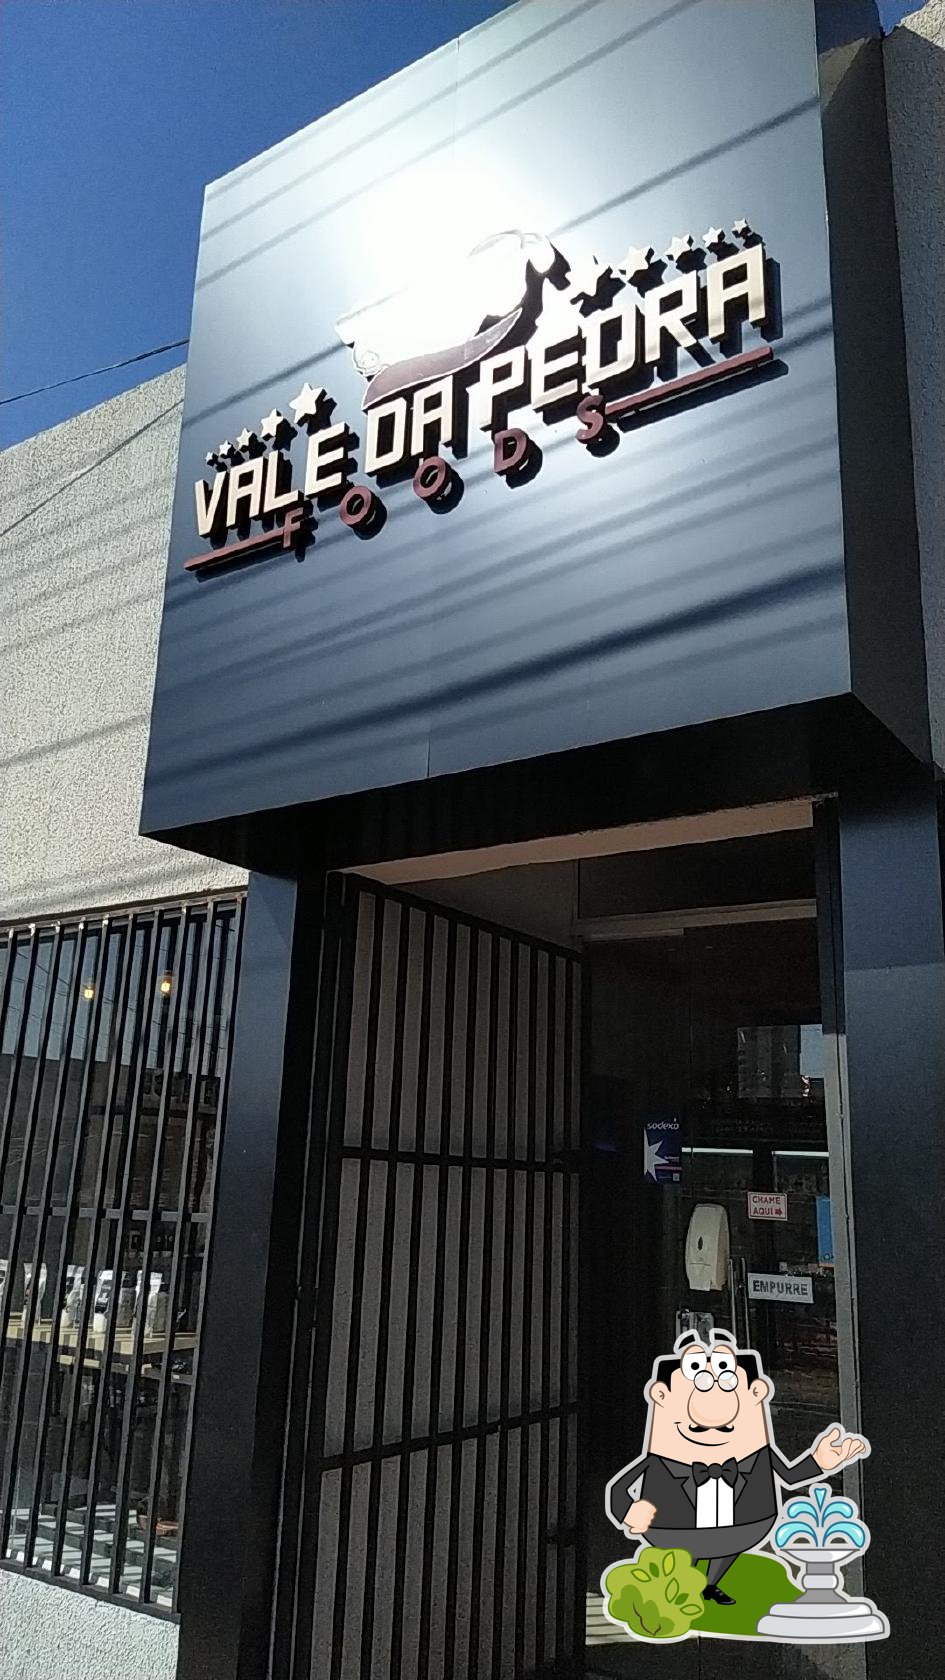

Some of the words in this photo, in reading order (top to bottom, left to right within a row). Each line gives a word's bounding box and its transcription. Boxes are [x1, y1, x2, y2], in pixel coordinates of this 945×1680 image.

[194, 421, 348, 537] VALE
[364, 376, 453, 476] DA
[467, 243, 767, 433] PEDRA
[283, 393, 605, 549] FOODS
[647, 1119, 680, 1131] sodexo
[752, 1196, 781, 1205] CHAME
[753, 1207, 774, 1216] AQUI
[752, 1280, 808, 1296] EMPURRE
